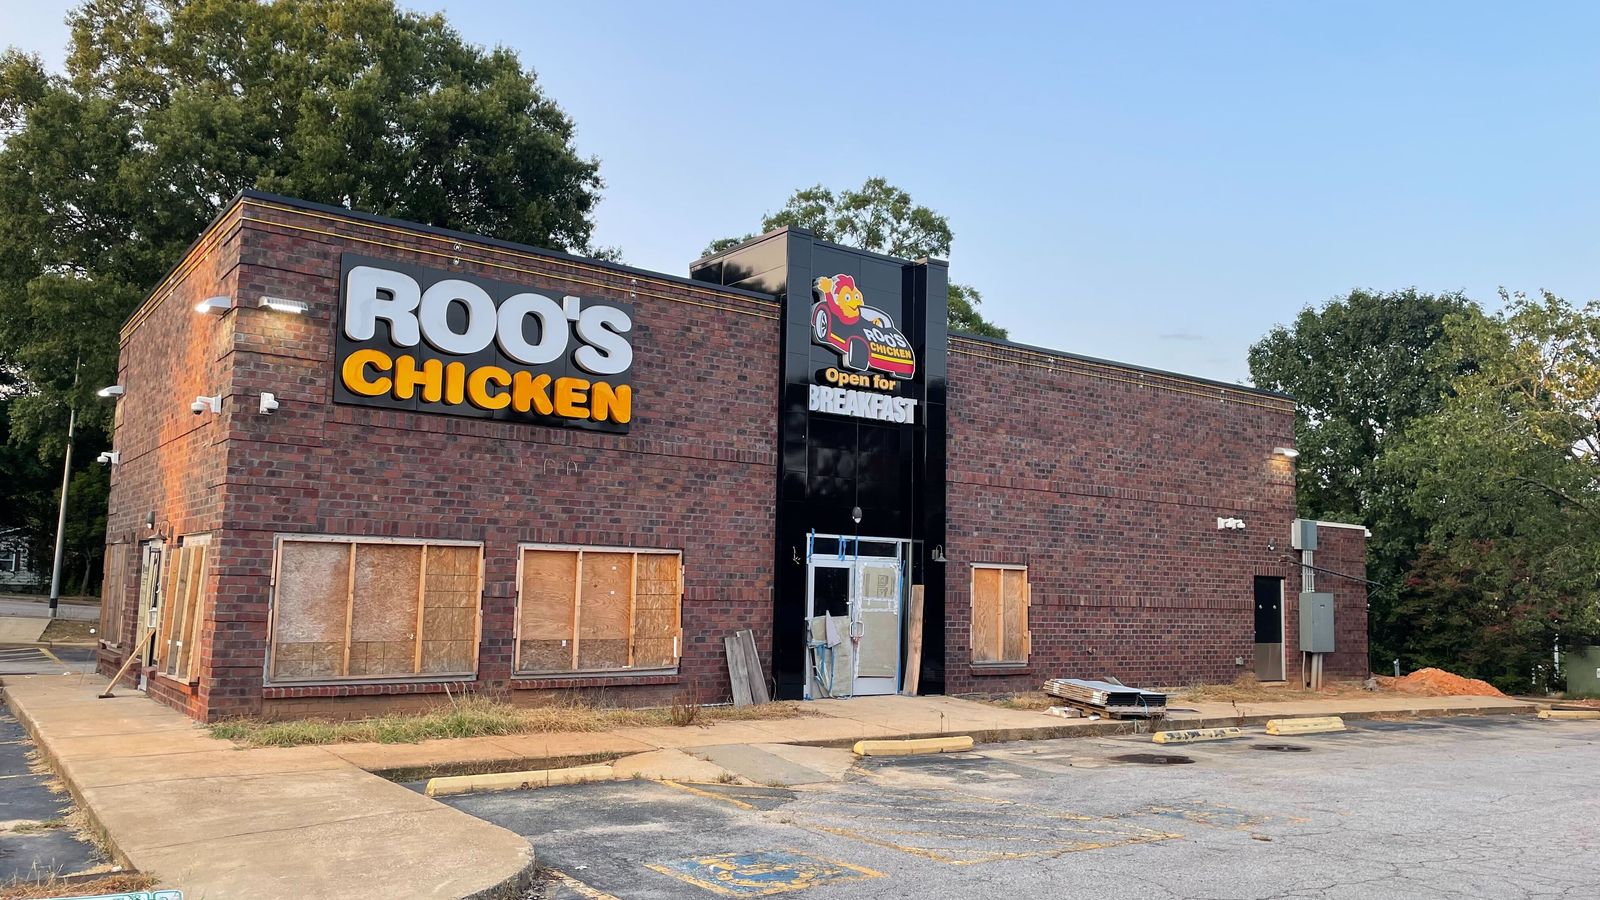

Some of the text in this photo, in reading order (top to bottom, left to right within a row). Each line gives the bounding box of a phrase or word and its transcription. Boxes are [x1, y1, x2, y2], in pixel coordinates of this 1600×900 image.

[345, 265, 633, 375] ROO'S
[863, 328, 907, 347] ROO'S
[869, 342, 912, 359] CHICKEN
[342, 348, 632, 424] CHICKEN
[825, 368, 896, 390] Open for
[809, 384, 918, 424] BREAKFAST
